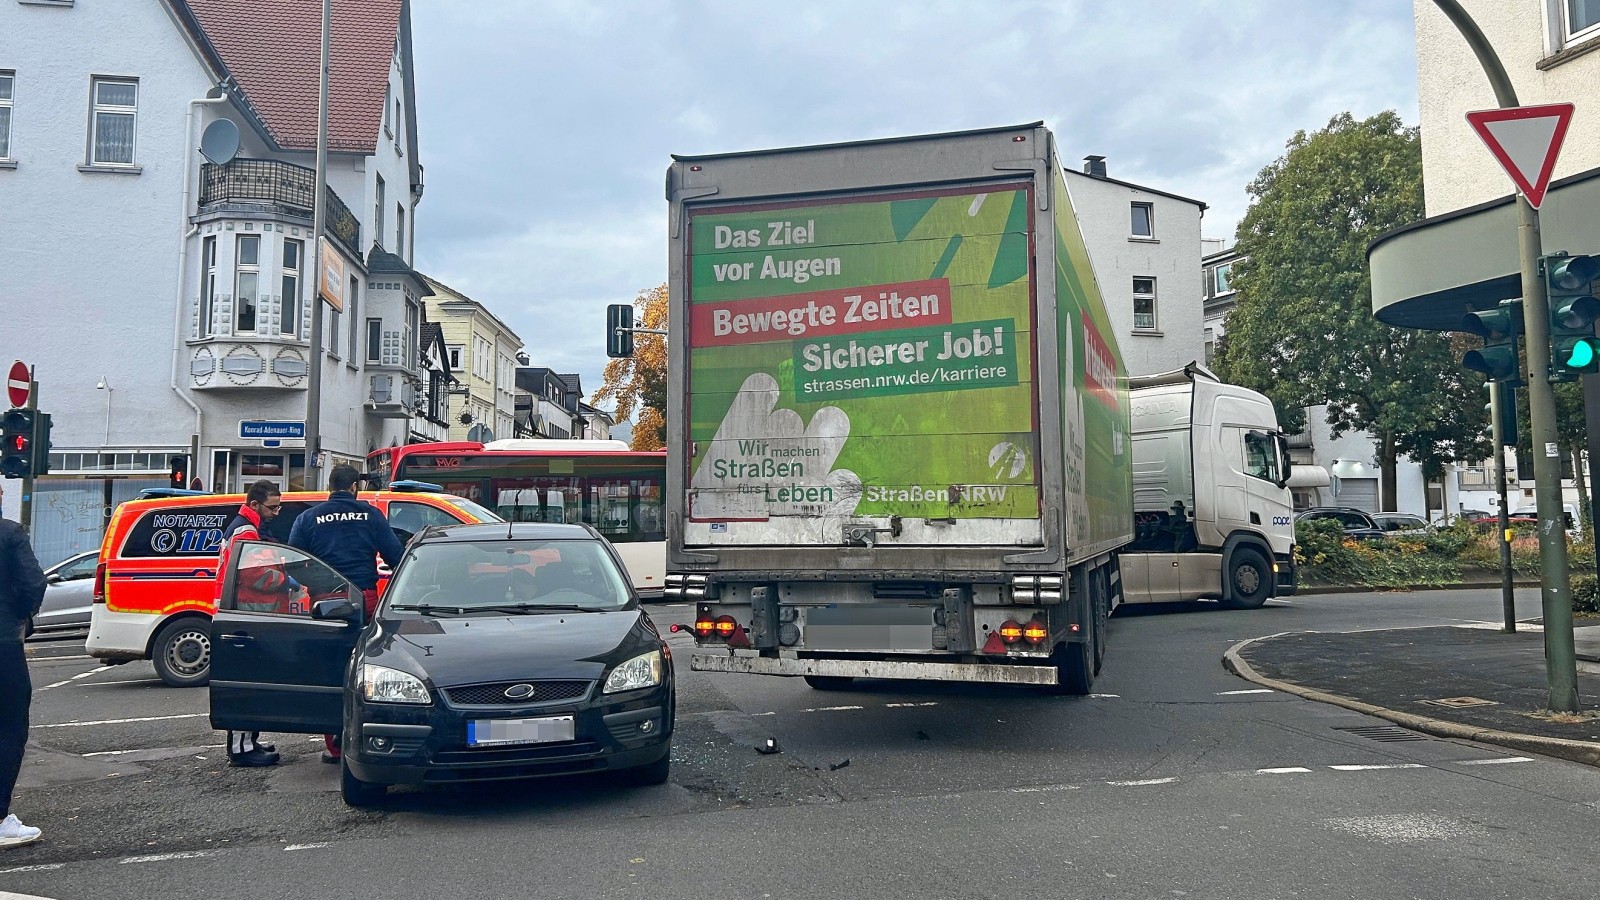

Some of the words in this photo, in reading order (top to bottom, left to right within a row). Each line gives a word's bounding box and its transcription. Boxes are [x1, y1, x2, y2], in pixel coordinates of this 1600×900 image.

[714, 224, 761, 249] Das
[767, 220, 815, 245] Ziel
[713, 259, 754, 282] vor
[759, 255, 841, 283] Augen
[713, 301, 836, 336] Bewegte
[843, 292, 939, 324] Zeiten
[803, 339, 929, 372] Sicherer
[936, 327, 1004, 360] Job!
[803, 364, 1007, 394] strassen.nrw.de/karriere
[244, 426, 301, 435] Konrad-Adenauer-Ring
[738, 440, 769, 456] Wir
[771, 446, 820, 457] machen
[436, 457, 461, 467] MVG
[713, 458, 803, 478] Straßen
[737, 483, 761, 494] fürs
[765, 482, 833, 502] Leben
[866, 485, 949, 502] Straßen
[153, 514, 227, 527] NOTARZT
[316, 512, 368, 524] NOTARZT
[176, 528, 223, 552] 112
